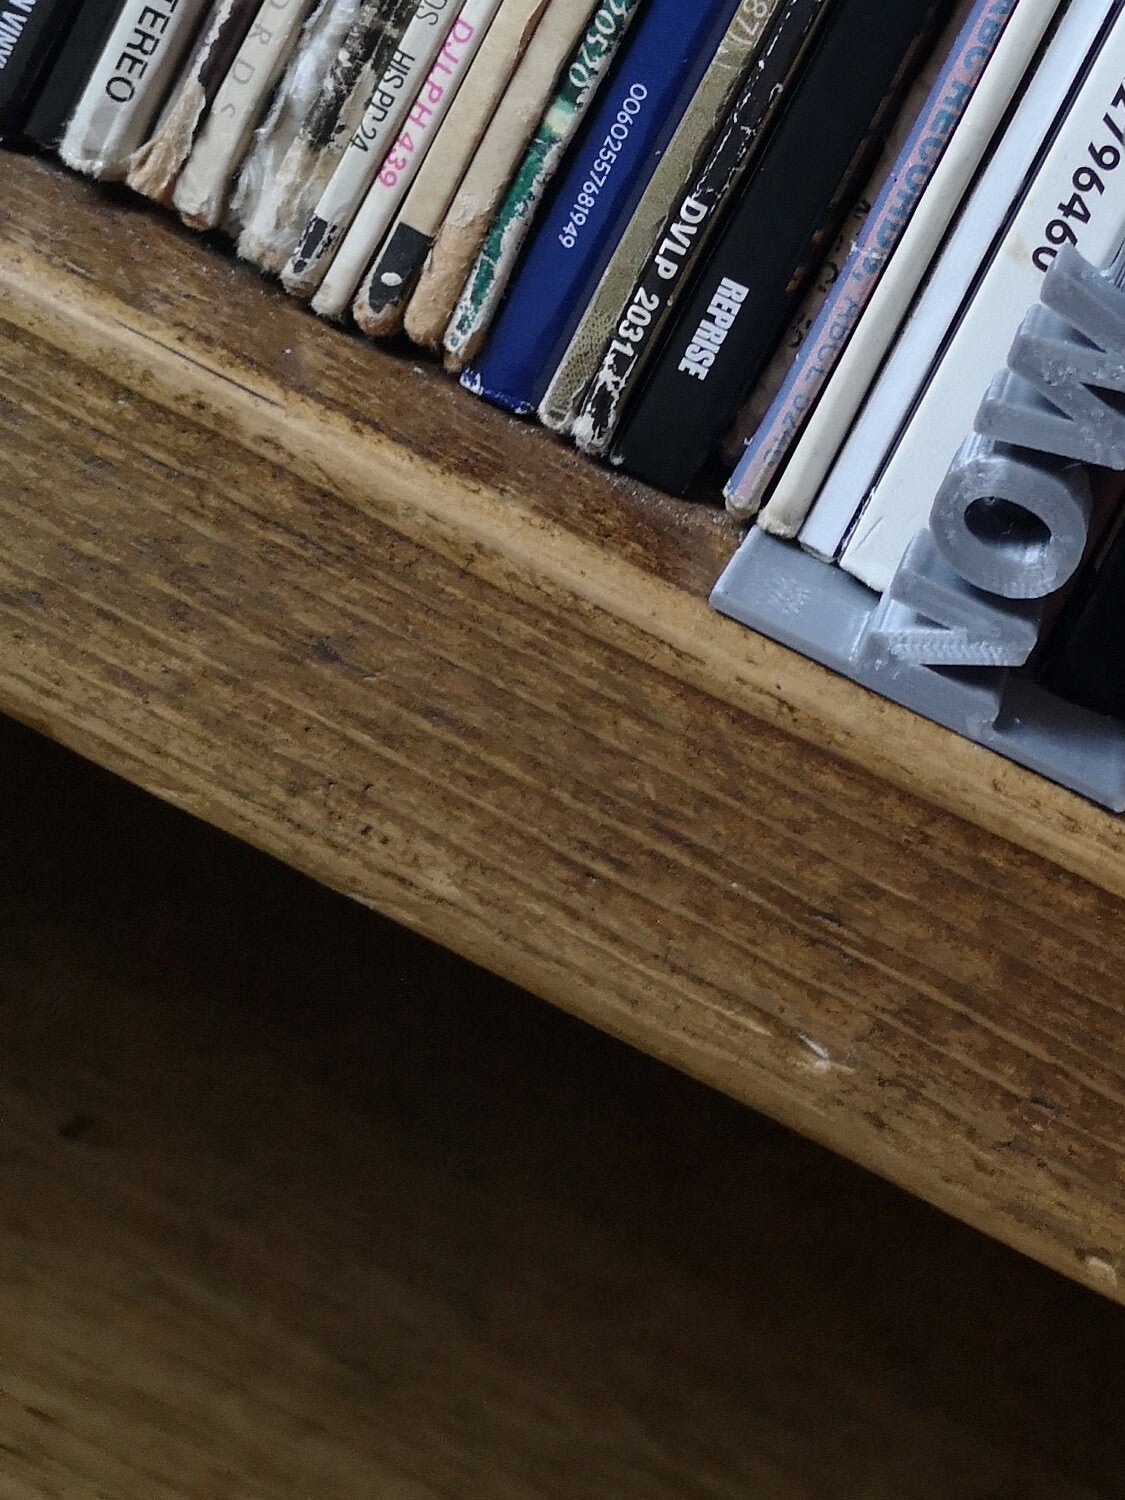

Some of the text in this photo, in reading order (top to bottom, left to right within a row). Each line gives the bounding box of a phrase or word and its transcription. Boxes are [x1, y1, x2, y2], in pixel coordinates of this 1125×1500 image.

[372, 15, 475, 192] DJLPH 439
[552, 80, 650, 251] 00602557681949
[647, 194, 708, 284] DVLP
[675, 275, 749, 382] REPRISE
